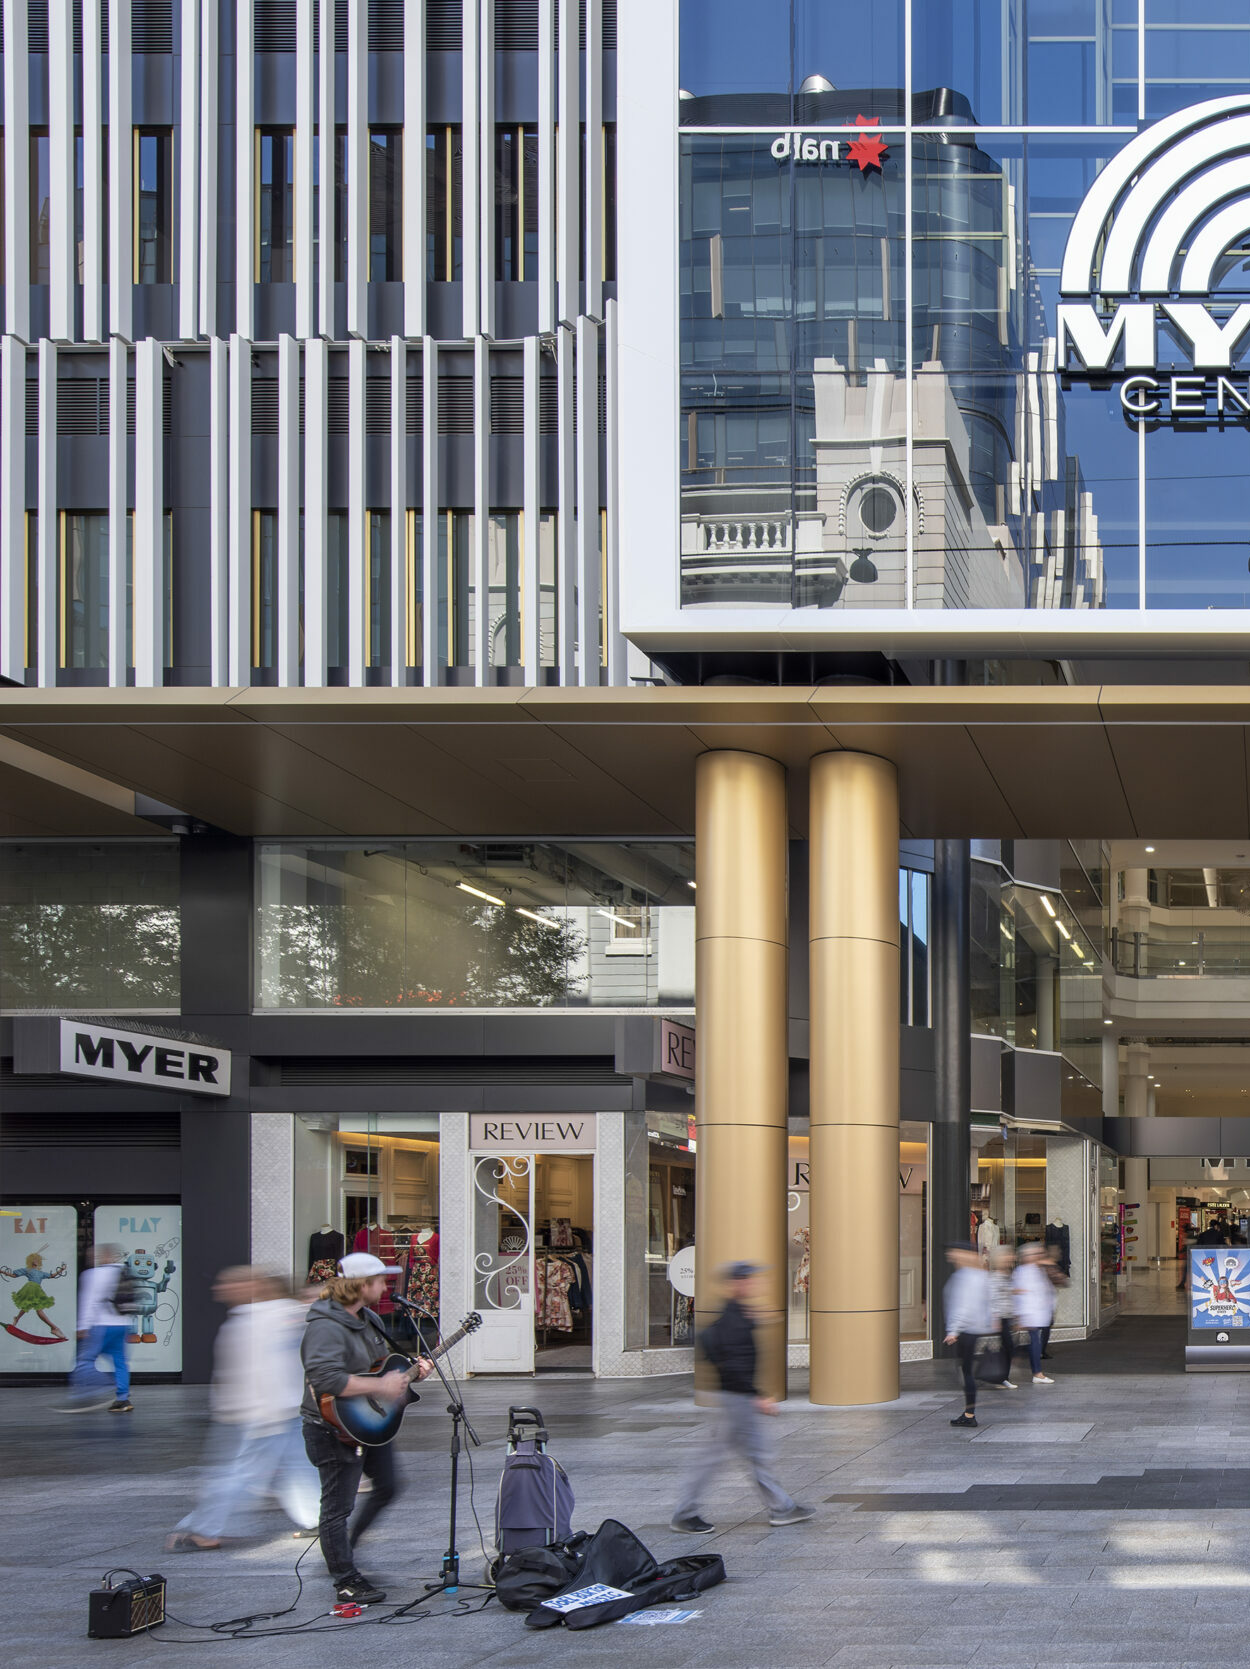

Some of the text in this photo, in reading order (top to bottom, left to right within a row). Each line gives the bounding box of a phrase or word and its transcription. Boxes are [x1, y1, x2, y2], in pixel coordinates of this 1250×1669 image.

[74, 1032, 219, 1084] MYER
[483, 1122, 584, 1141] REVIEW
[14, 1217, 49, 1234] EAT
[119, 1217, 162, 1233] PLAY
[505, 1265, 528, 1275] 25%
[505, 1276, 529, 1286] OFF
